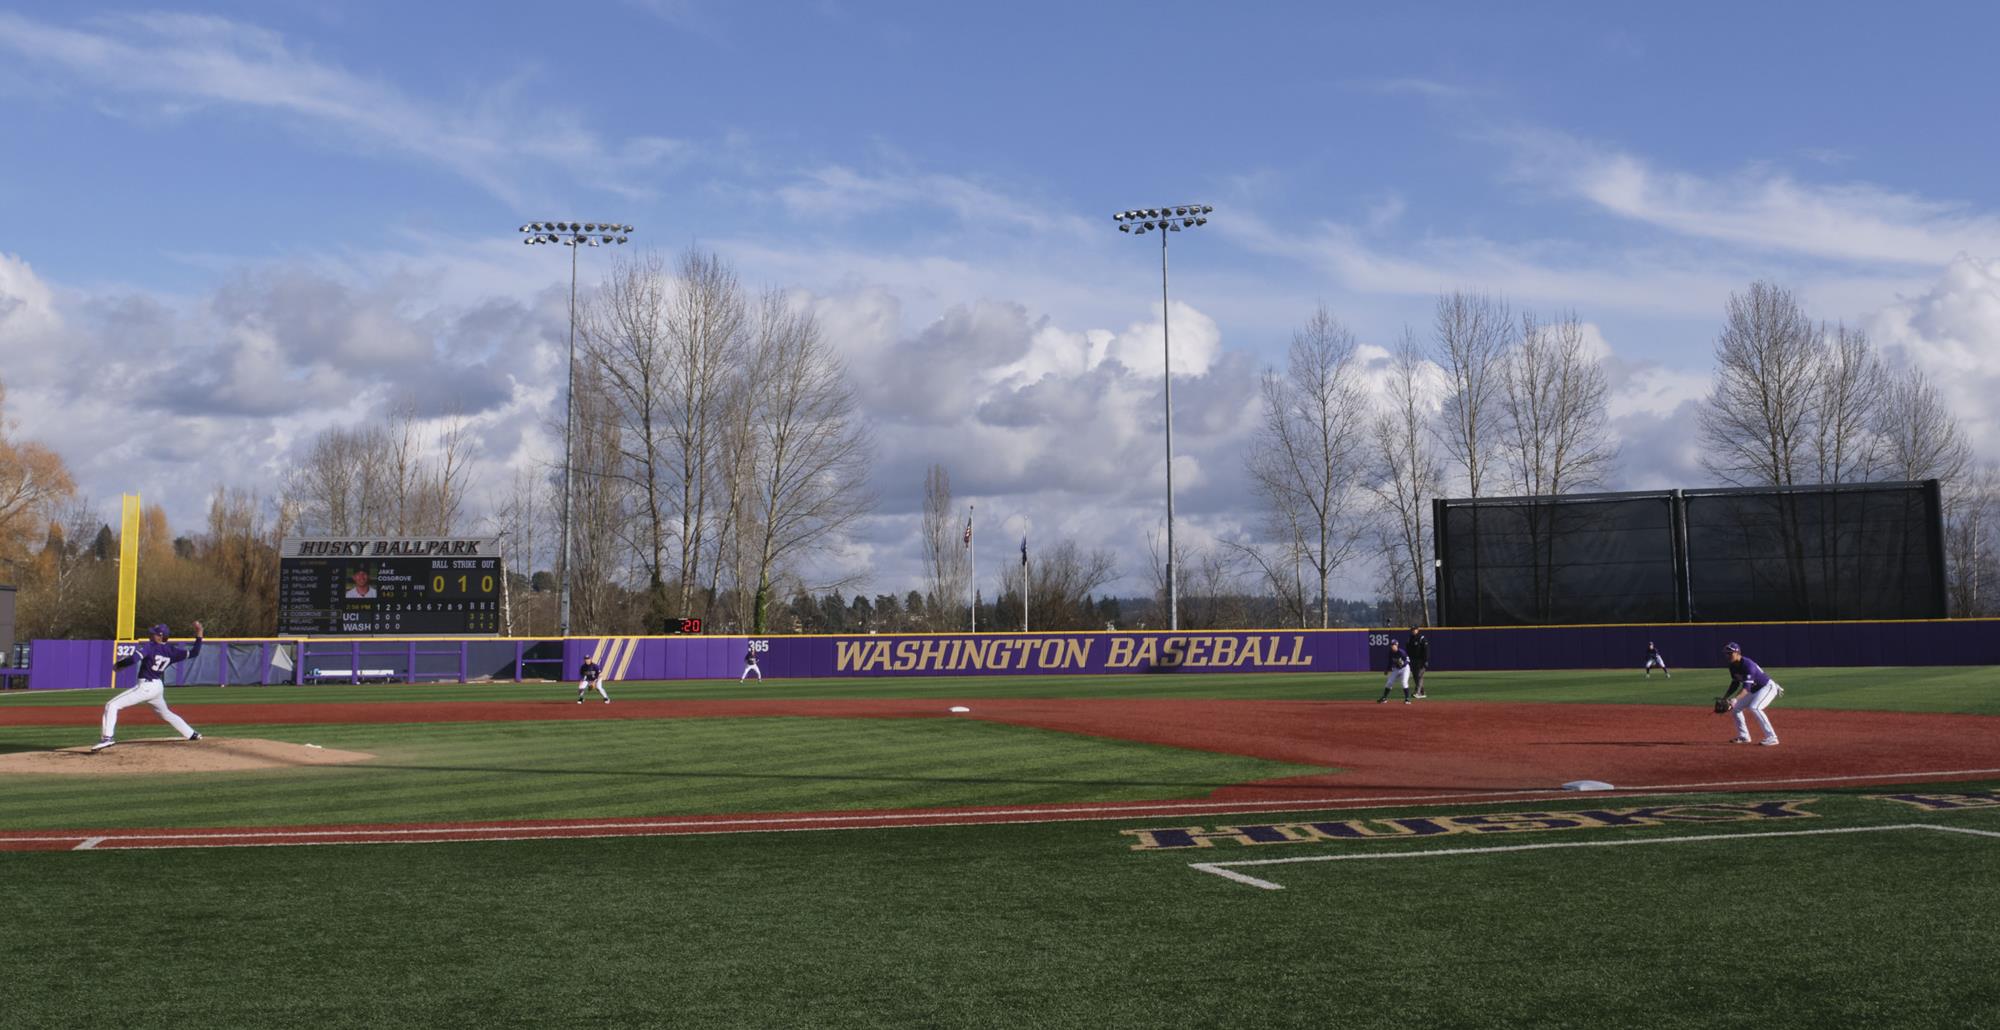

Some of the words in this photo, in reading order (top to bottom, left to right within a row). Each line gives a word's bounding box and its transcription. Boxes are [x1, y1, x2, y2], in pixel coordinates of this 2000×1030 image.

[300, 541, 369, 555] HUSKY
[373, 540, 480, 555] BALLPARK
[432, 560, 448, 568] BALL
[452, 560, 476, 568] STRIKE
[481, 560, 495, 568] OUT
[433, 575, 445, 592] 0
[458, 575, 467, 592] 1
[481, 575, 493, 592] 0
[343, 613, 359, 621] UCI
[343, 623, 371, 631] WASH
[748, 640, 769, 652] 365
[1369, 634, 1389, 646] 385
[117, 645, 135, 656] 327
[836, 637, 1095, 672] WASHINGTON
[1104, 635, 1313, 668] BASEBALL
[151, 655, 171, 672] 37
[1119, 796, 1822, 850] HUSKY
